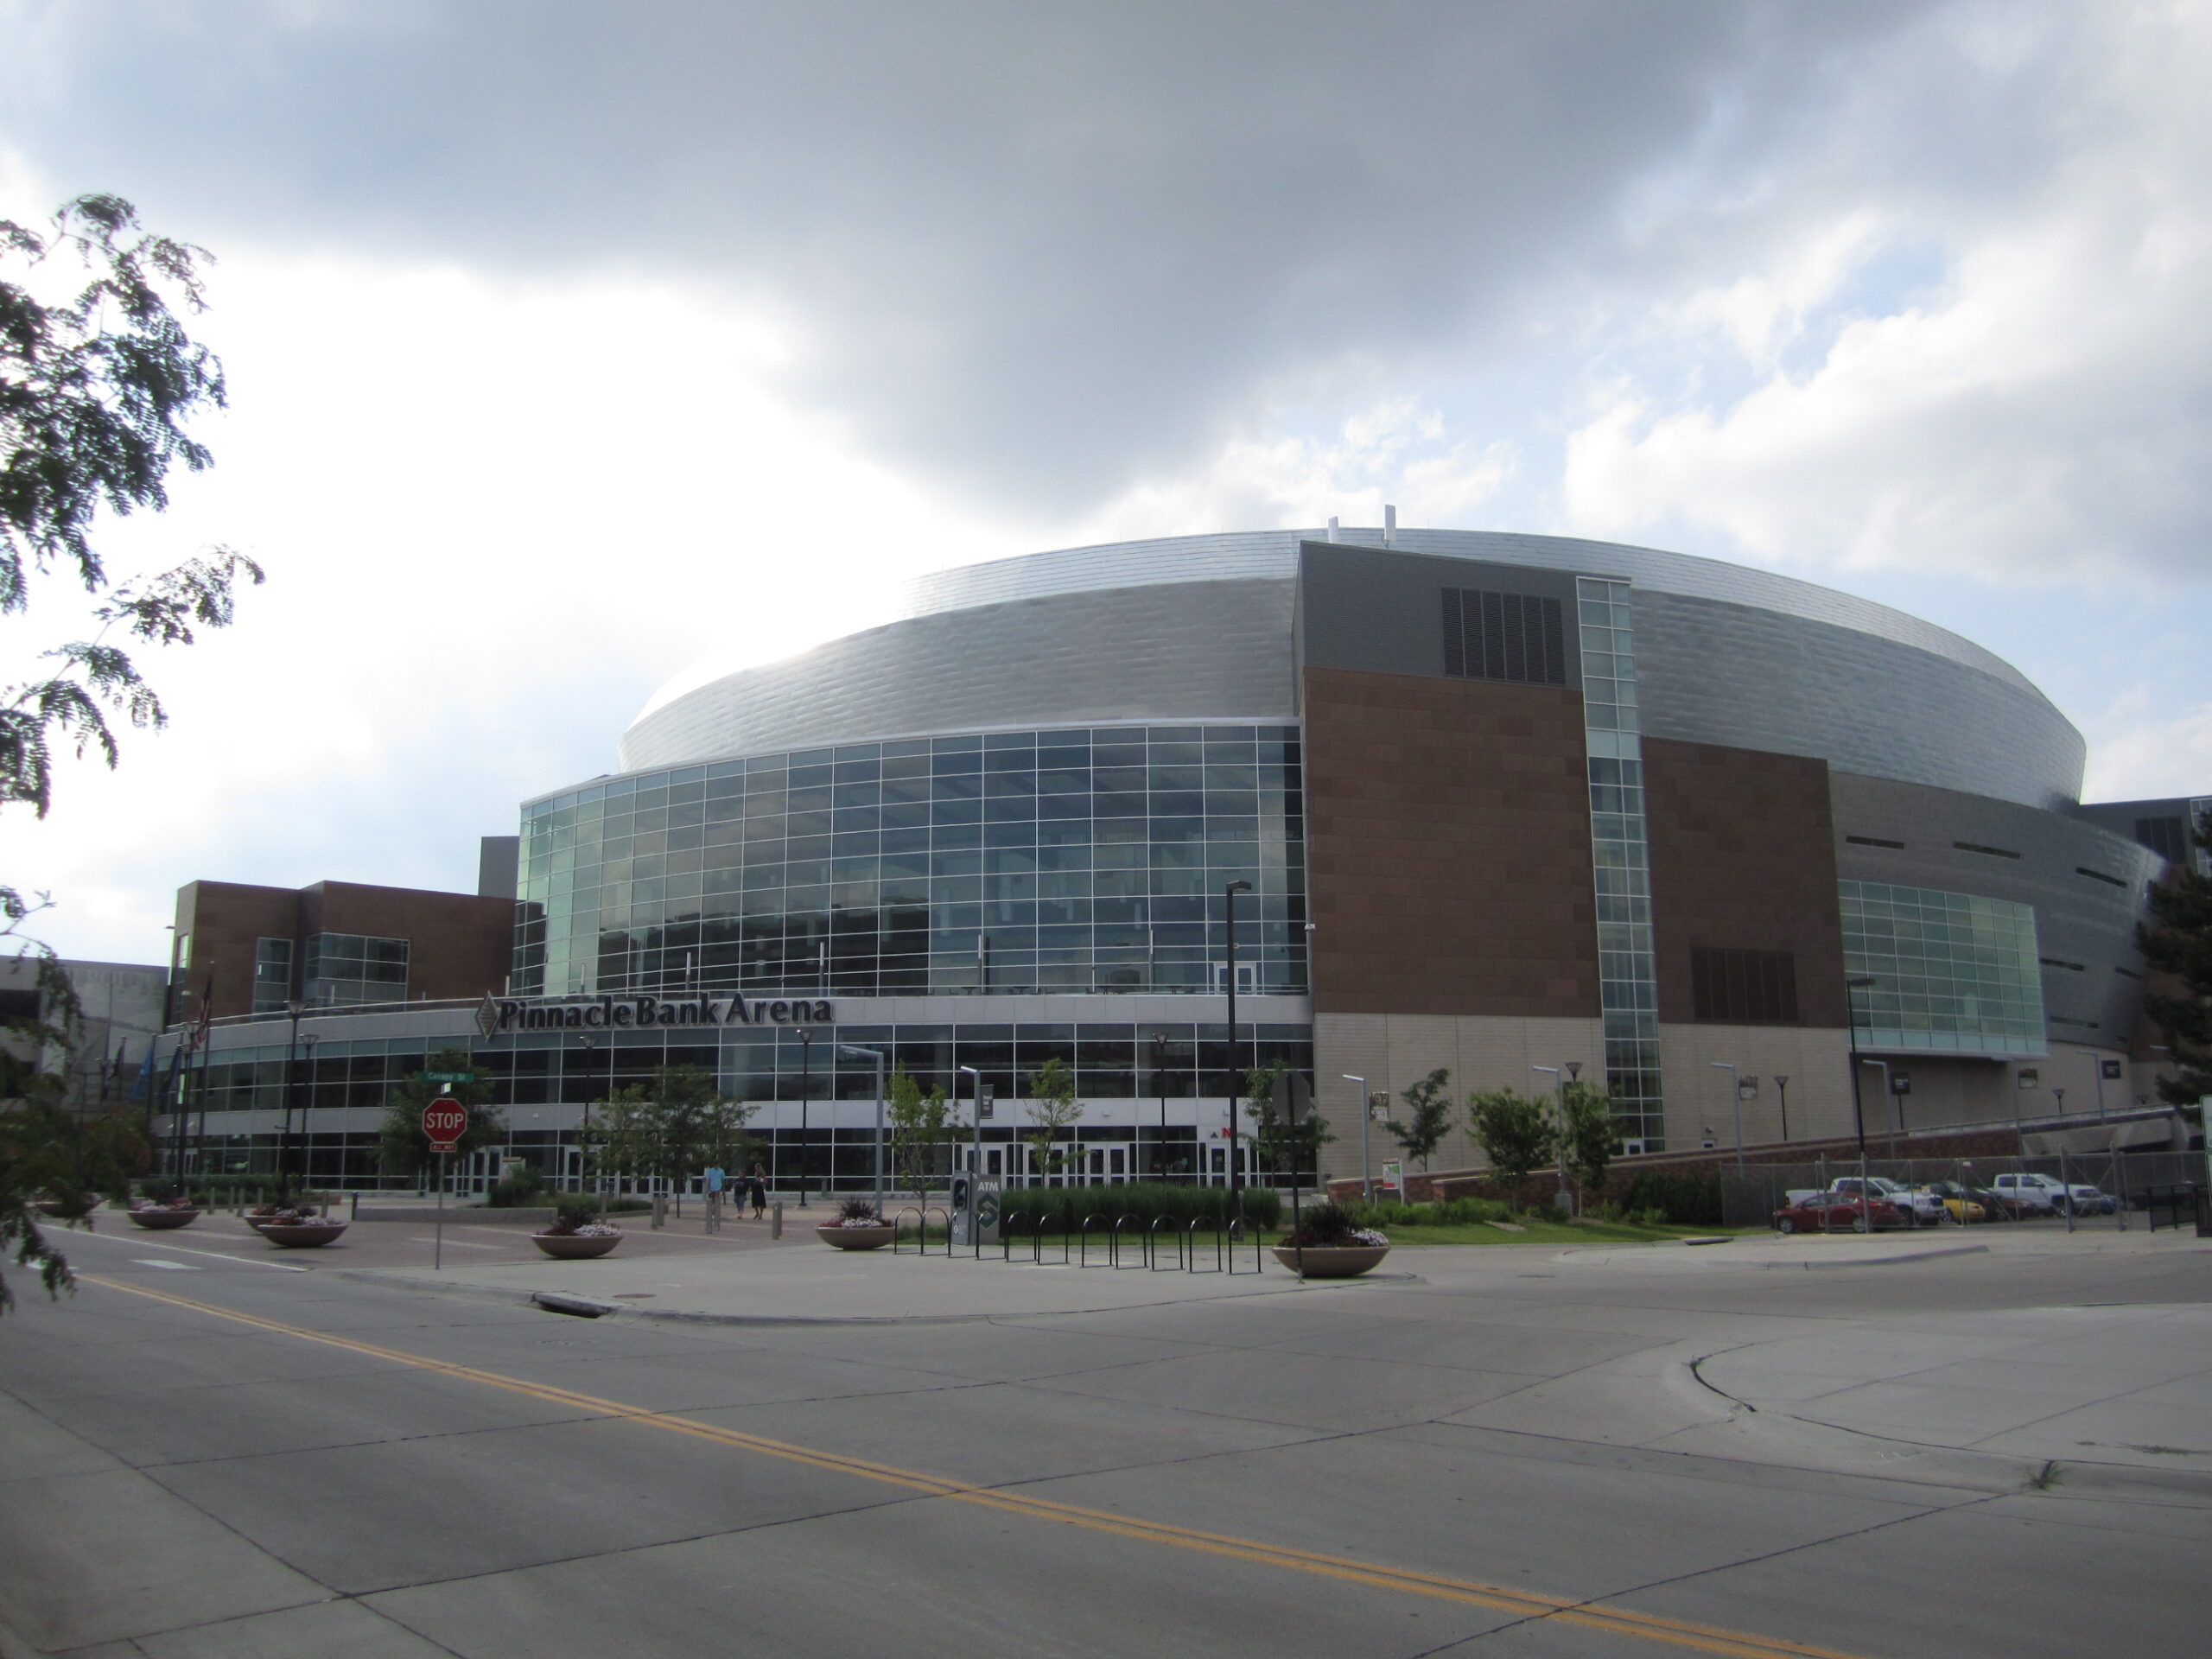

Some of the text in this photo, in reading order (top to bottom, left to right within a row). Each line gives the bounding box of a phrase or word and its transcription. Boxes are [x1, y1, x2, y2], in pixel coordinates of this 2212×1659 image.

[499, 992, 834, 1031] Pinnacle Bank Arena
[426, 1113, 464, 1129] STOP
[977, 1181, 999, 1192] ATM
